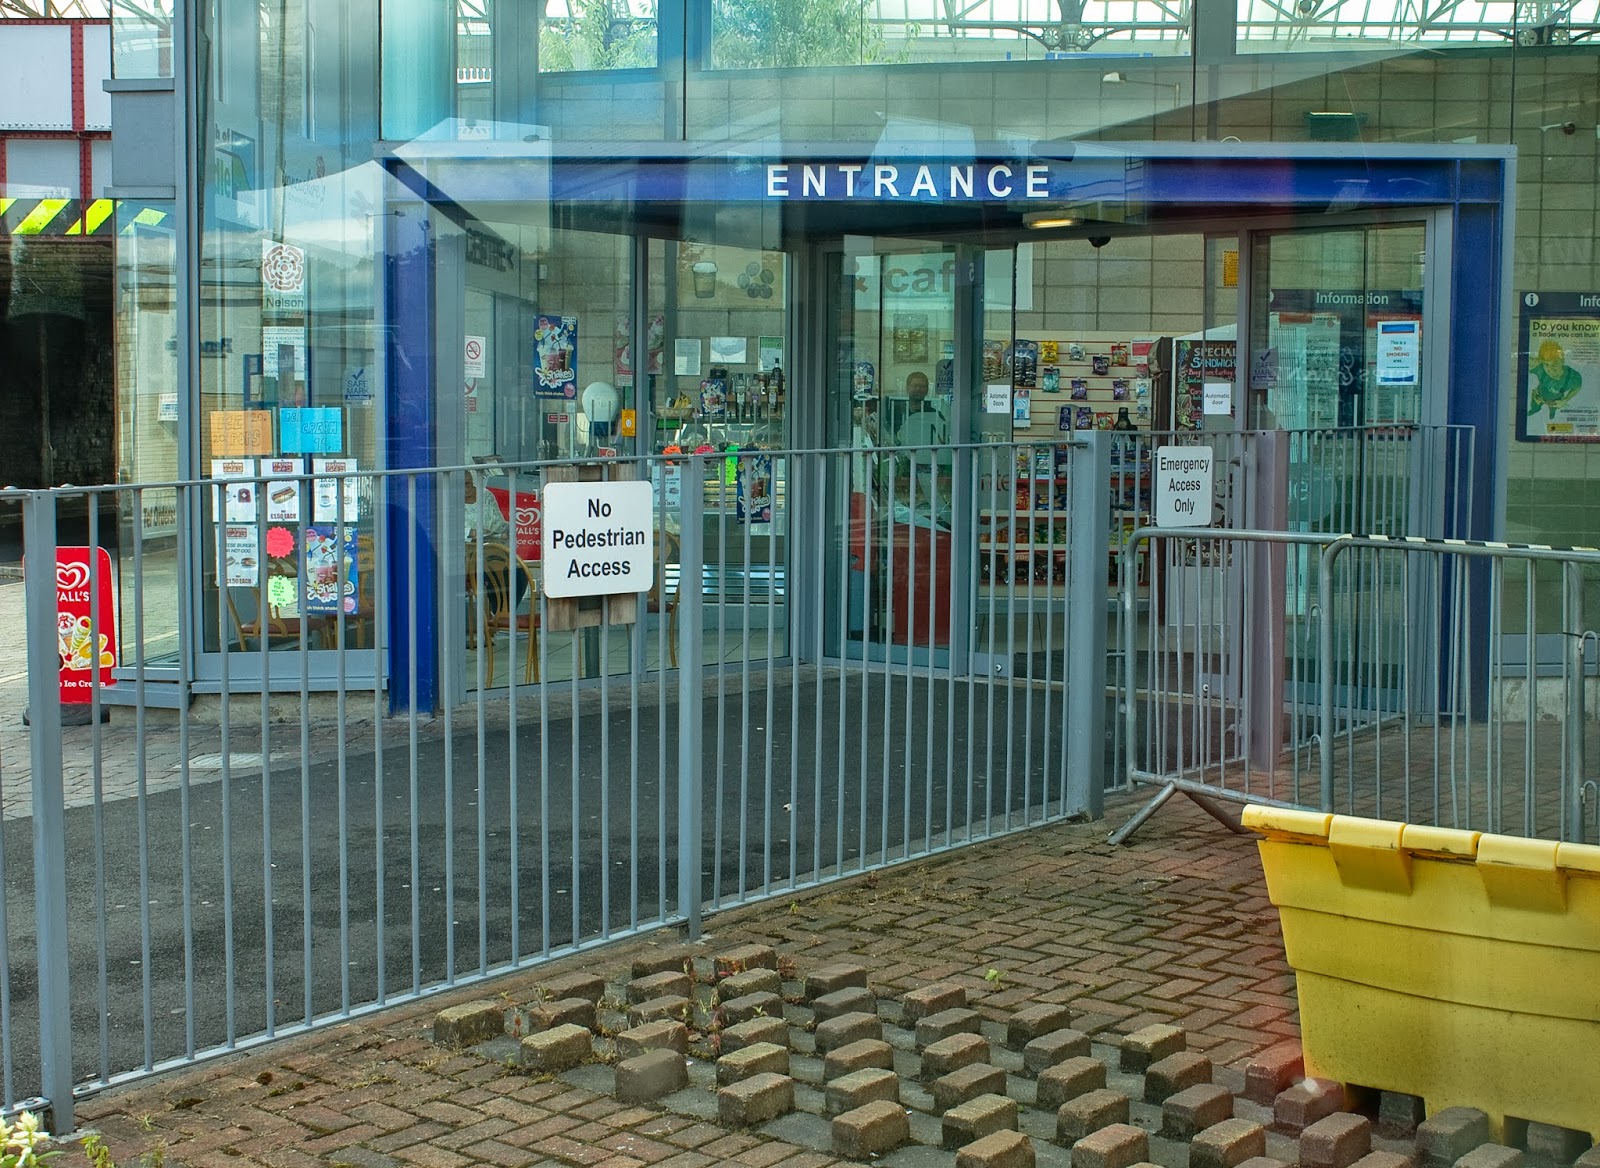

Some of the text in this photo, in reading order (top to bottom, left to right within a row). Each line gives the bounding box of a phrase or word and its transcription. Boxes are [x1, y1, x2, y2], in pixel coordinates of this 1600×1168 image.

[766, 164, 1050, 198] ENTRANCE
[884, 259, 955, 293] caf
[266, 297, 304, 308] Nelson
[1316, 291, 1389, 305] Information
[1532, 321, 1600, 333] Do you know
[347, 380, 369, 388] SAFE
[302, 420, 338, 435] CREAM
[1160, 457, 1210, 474] Emergency
[1168, 477, 1201, 492] Access
[587, 499, 613, 518] No
[1174, 498, 1195, 515] Only
[515, 527, 540, 535] ALL'S
[552, 527, 645, 549] Pedestrian
[567, 558, 632, 579] Access
[316, 582, 353, 594] shaes
[56, 591, 90, 602] ALL'S
[63, 680, 106, 688] Ice Crem
